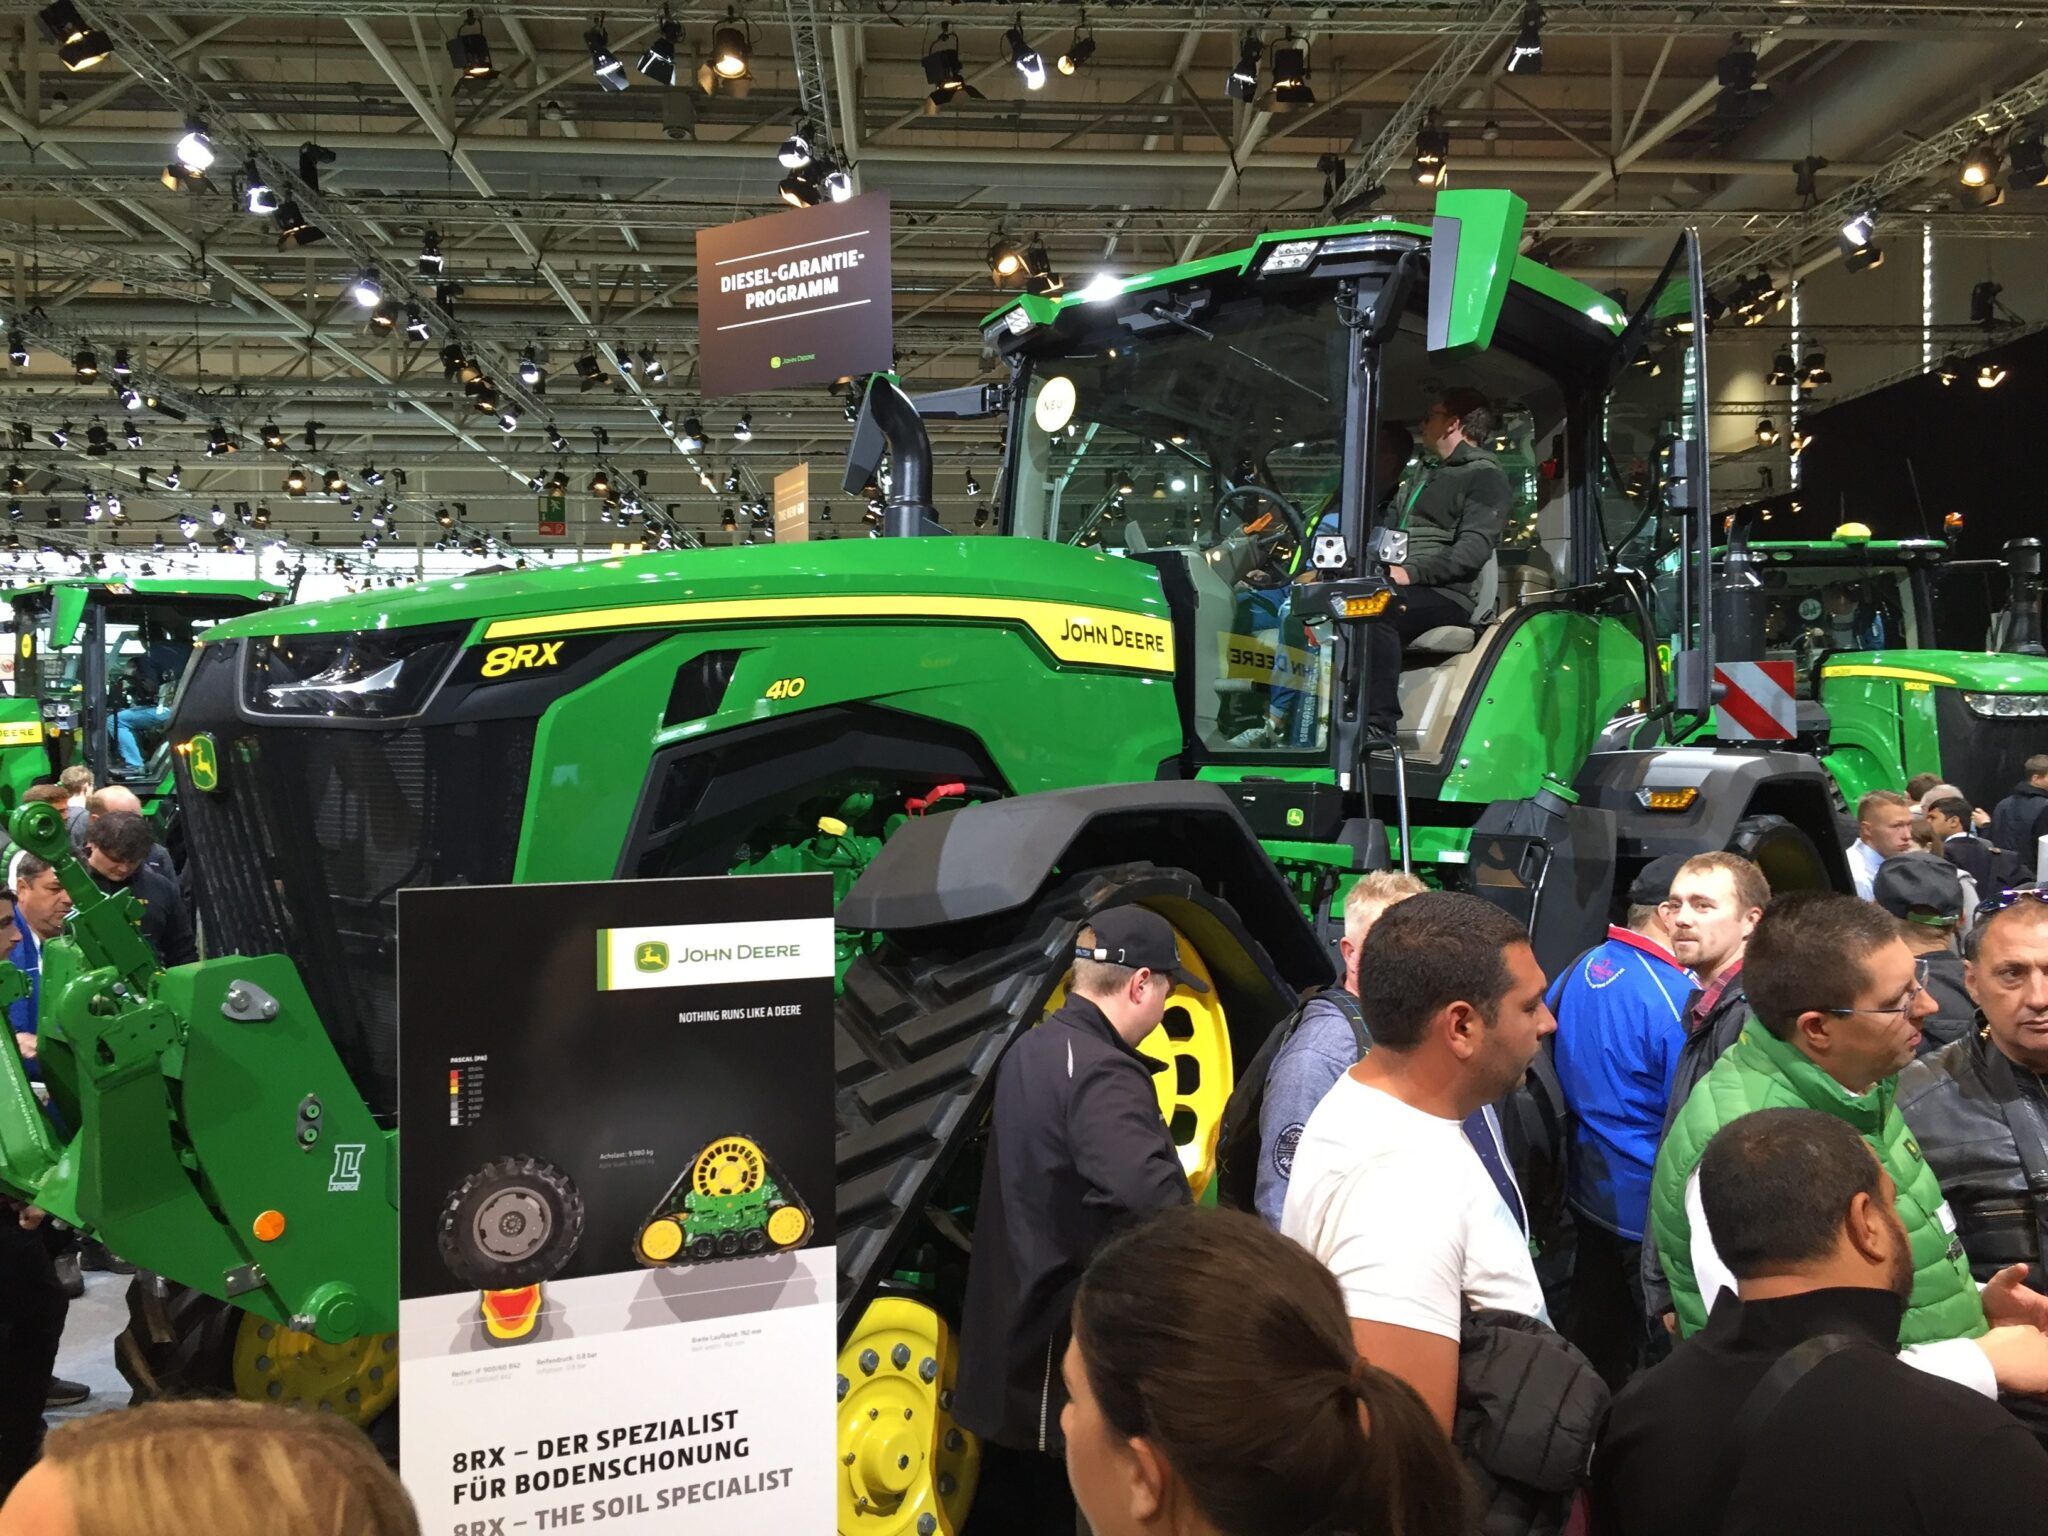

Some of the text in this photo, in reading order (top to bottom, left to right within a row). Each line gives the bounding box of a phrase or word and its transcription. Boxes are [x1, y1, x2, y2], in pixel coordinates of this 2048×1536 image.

[720, 249, 865, 293] DIESEL-GARANTIE-
[745, 276, 839, 310] PROGRAMM
[1061, 618, 1165, 653] JOHN DEERE
[480, 640, 565, 678] 8RX
[764, 676, 807, 701] 410
[0, 728, 35, 738] EERE
[678, 944, 801, 963] JOHN DEERE
[679, 1004, 802, 1023] NOTHING RUNS LIKE A DEERE
[452, 1446, 506, 1474] 8RX
[537, 1433, 589, 1460] DER
[596, 1409, 739, 1451] SPEZIALIST
[453, 1437, 750, 1505] FÜR BODENSCHONUNG
[453, 1516, 506, 1536] 8RX
[534, 1503, 586, 1531] THE
[592, 1493, 650, 1522] SOIL
[656, 1467, 794, 1510] SPECIALIST
